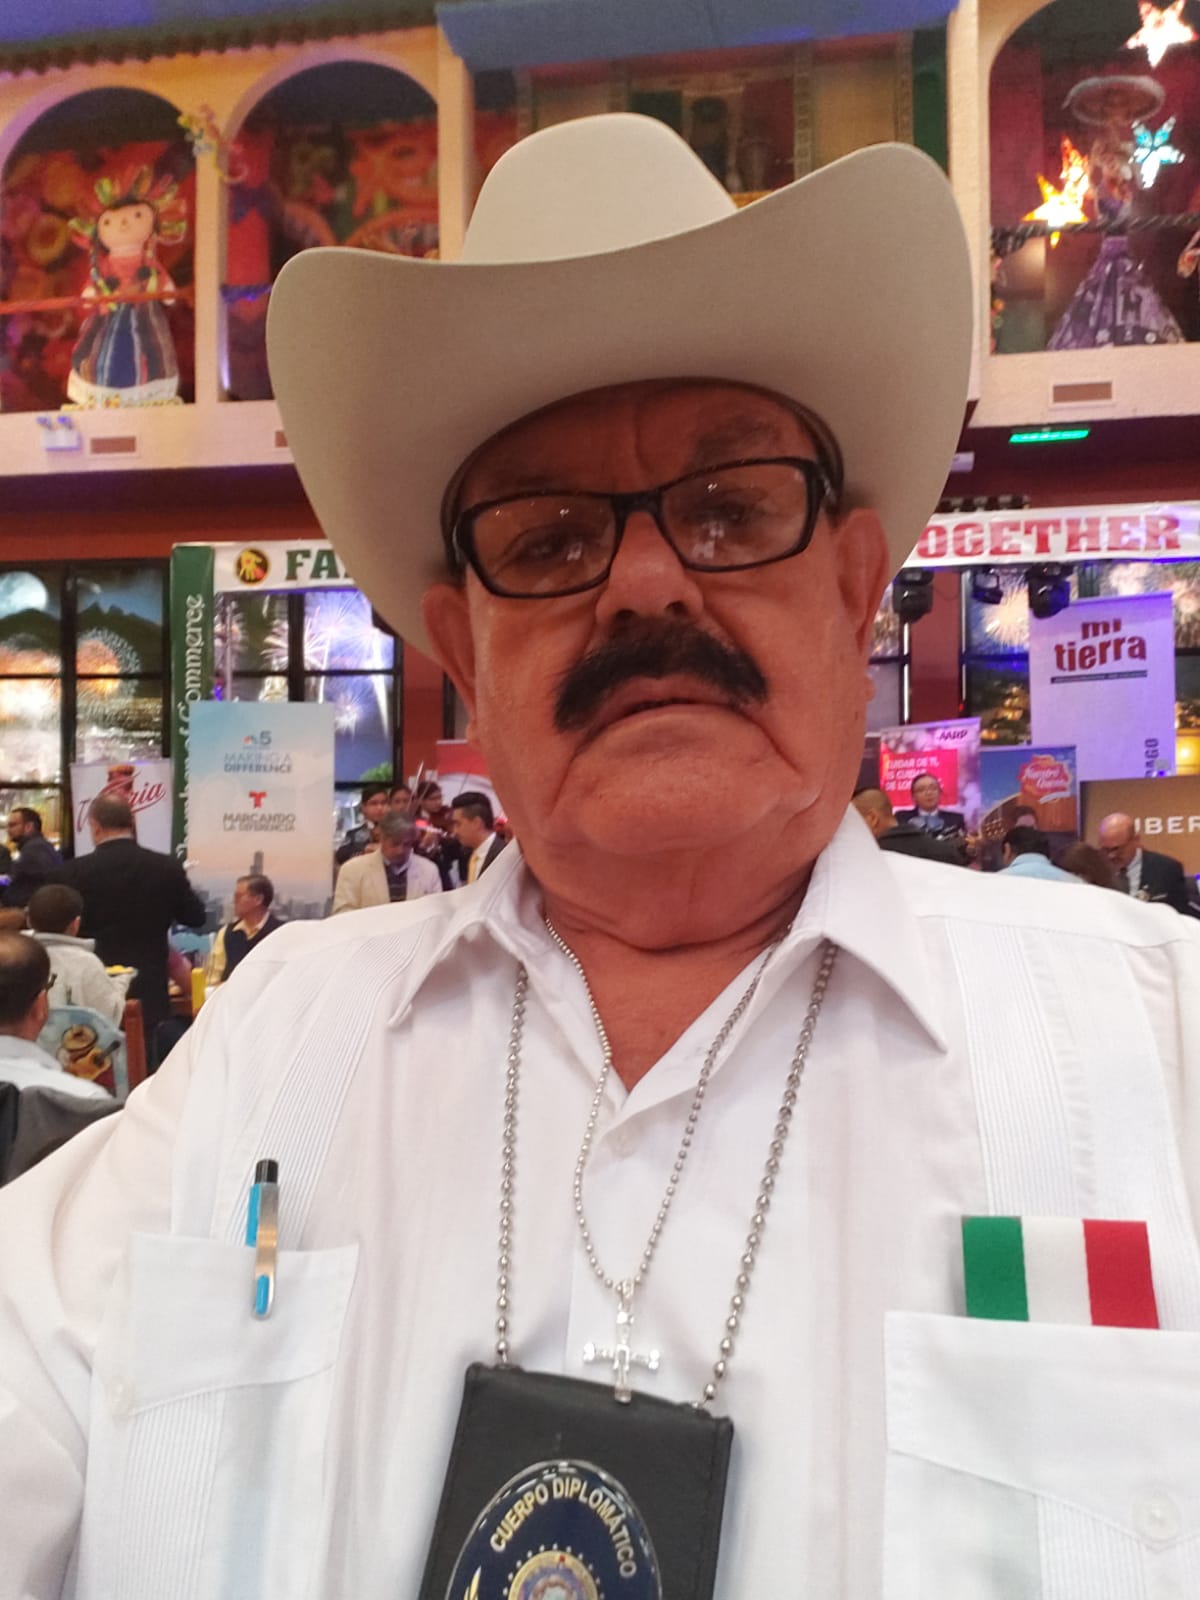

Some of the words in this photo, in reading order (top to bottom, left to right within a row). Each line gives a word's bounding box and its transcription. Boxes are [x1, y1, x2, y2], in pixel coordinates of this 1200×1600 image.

[917, 515, 1181, 558] OGETHER
[286, 549, 349, 580] FA
[1081, 618, 1122, 640] mi
[1054, 636, 1147, 672] tierra
[260, 731, 272, 746] 5
[223, 763, 292, 773] DIFFERENCE
[223, 812, 296, 823] MARCANDO
[490, 1483, 549, 1552] CUERPO
